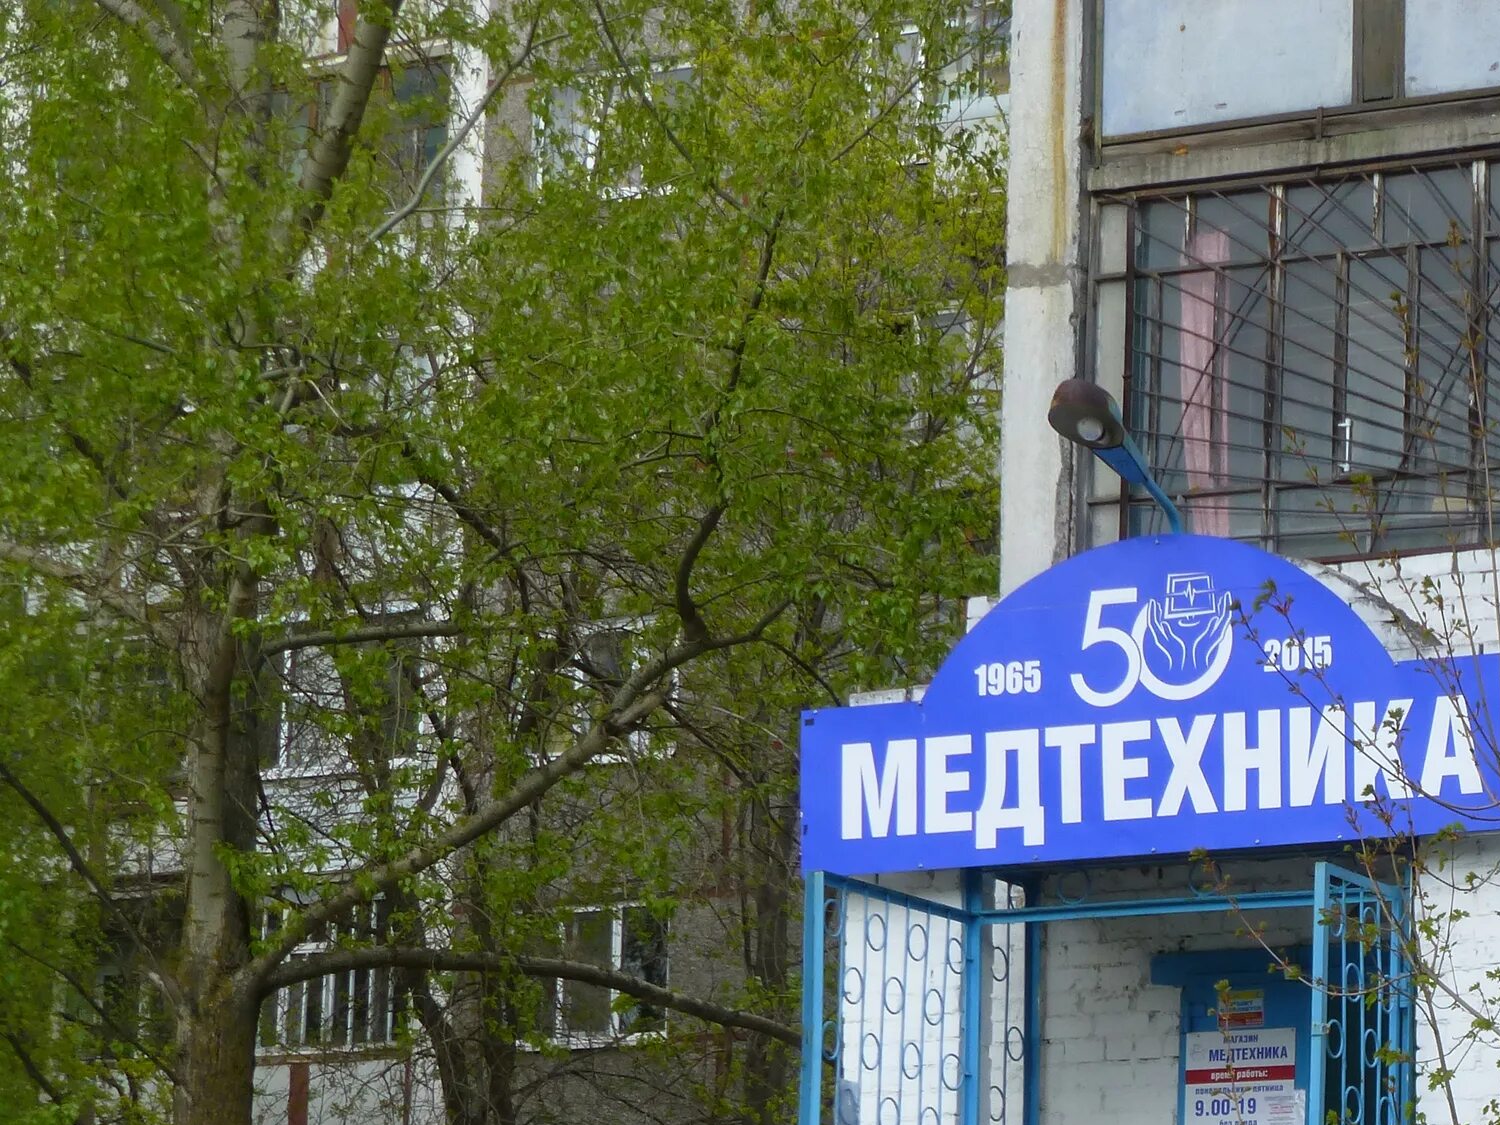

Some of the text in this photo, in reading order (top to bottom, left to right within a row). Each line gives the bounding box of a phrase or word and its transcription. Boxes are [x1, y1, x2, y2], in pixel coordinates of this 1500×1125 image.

[974, 660, 1042, 696] 1965
[1263, 636, 1332, 672] 2015
[841, 694, 1483, 850] МЕДТЕХНИКА
[1209, 1046, 1288, 1063] МЕДТЕХНИКА
[1210, 1072, 1236, 1081] врем
[1195, 1098, 1257, 1117] 9.00-19
